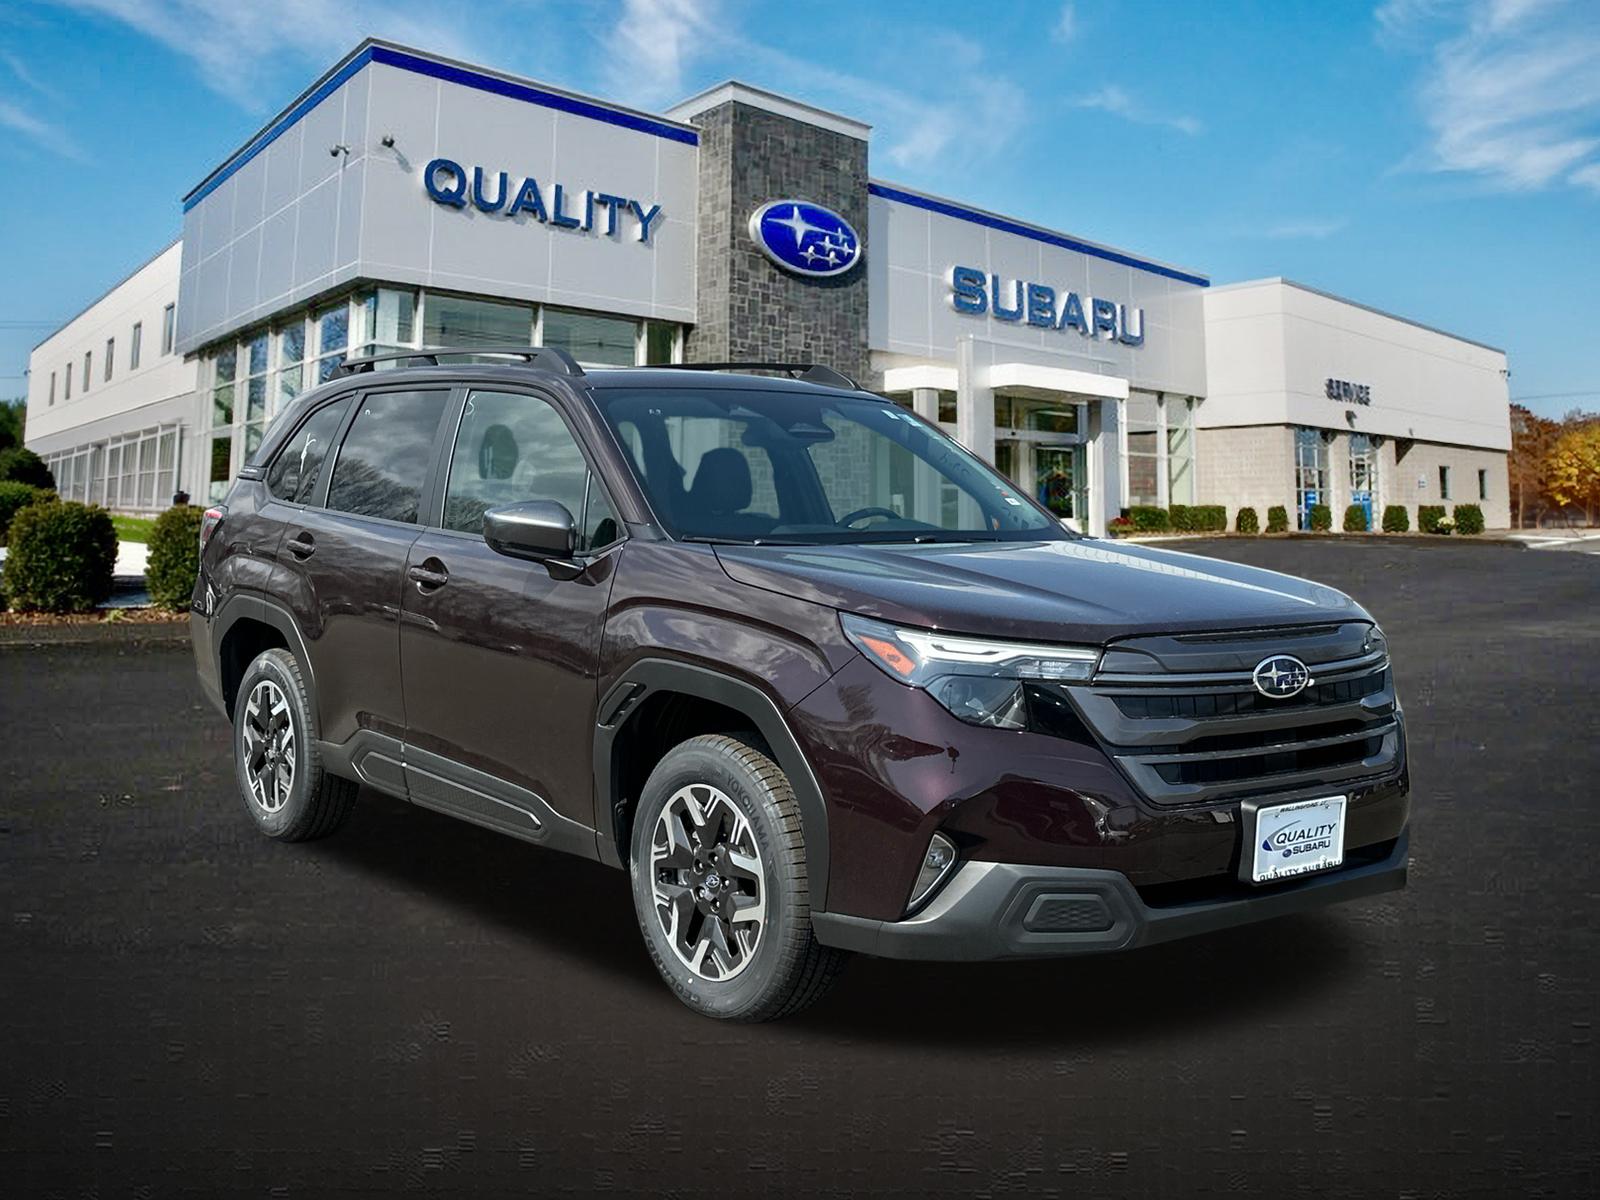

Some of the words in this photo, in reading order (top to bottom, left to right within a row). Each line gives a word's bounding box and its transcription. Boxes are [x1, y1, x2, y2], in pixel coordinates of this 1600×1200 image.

[422, 158, 662, 243] QUALITY
[945, 265, 1145, 347] SUBARU
[1325, 378, 1371, 407] SERVICE
[1276, 823, 1337, 845] QUALITY
[1292, 840, 1331, 855] SUBARU
[1260, 867, 1300, 881] QUALITY
[1303, 860, 1342, 873] SUBARU
